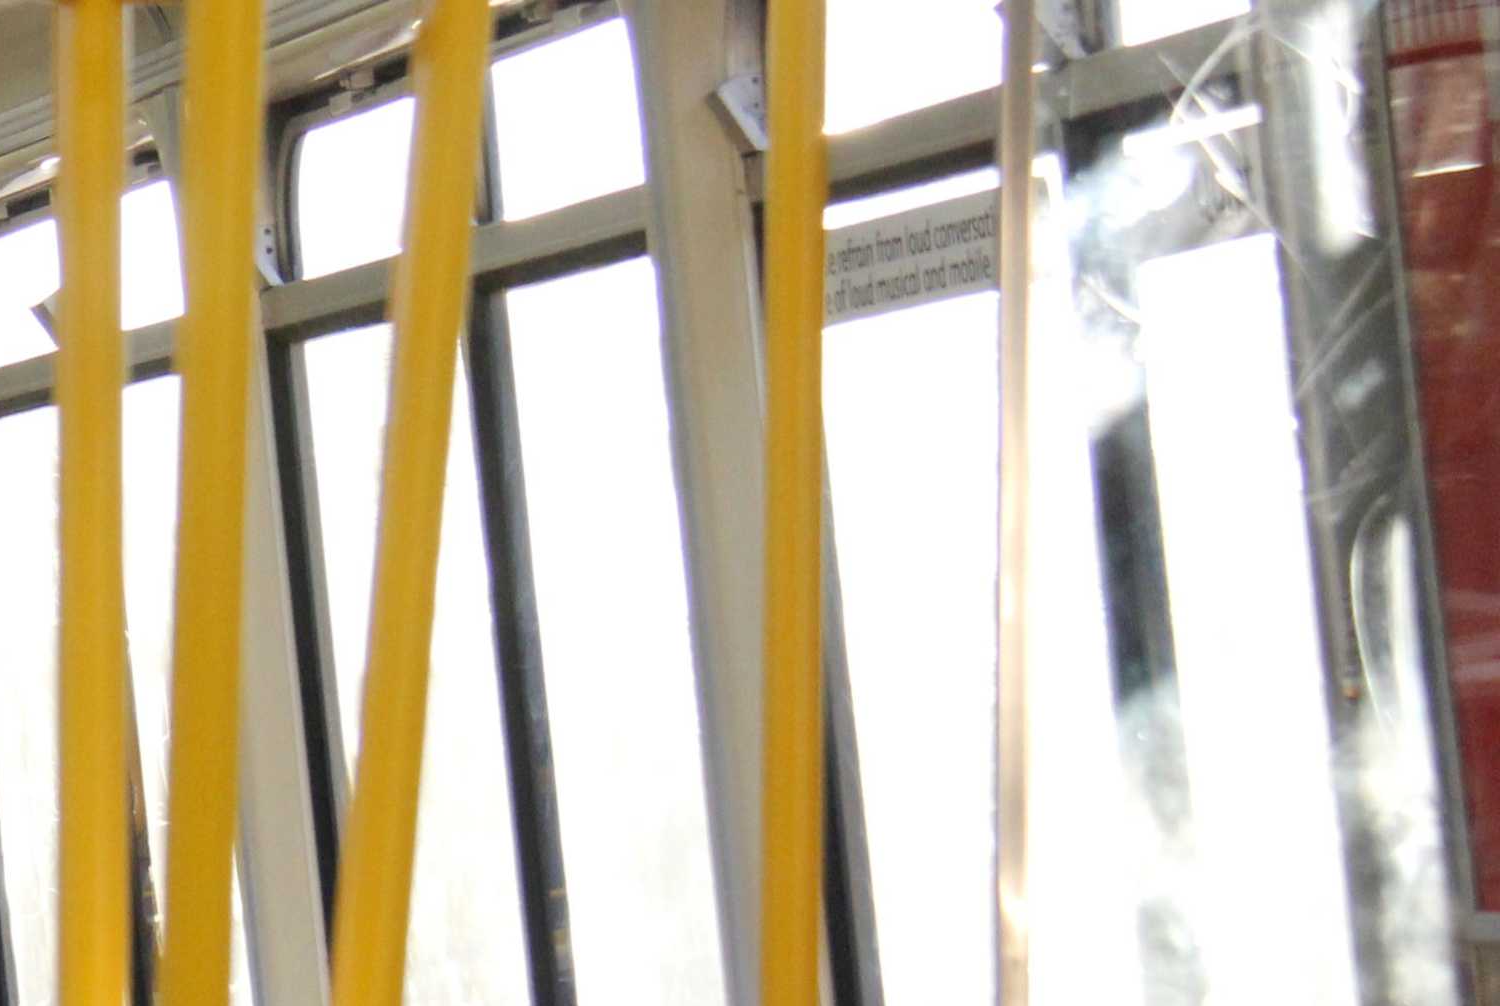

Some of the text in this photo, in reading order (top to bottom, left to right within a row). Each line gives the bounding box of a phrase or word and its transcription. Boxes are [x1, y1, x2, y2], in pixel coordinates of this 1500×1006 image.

[875, 229, 903, 263] from
[904, 216, 932, 255] loud
[933, 204, 997, 250] conversati
[835, 278, 848, 313] of
[849, 273, 876, 309] loud
[922, 256, 947, 292] and
[947, 247, 991, 287] mobile
